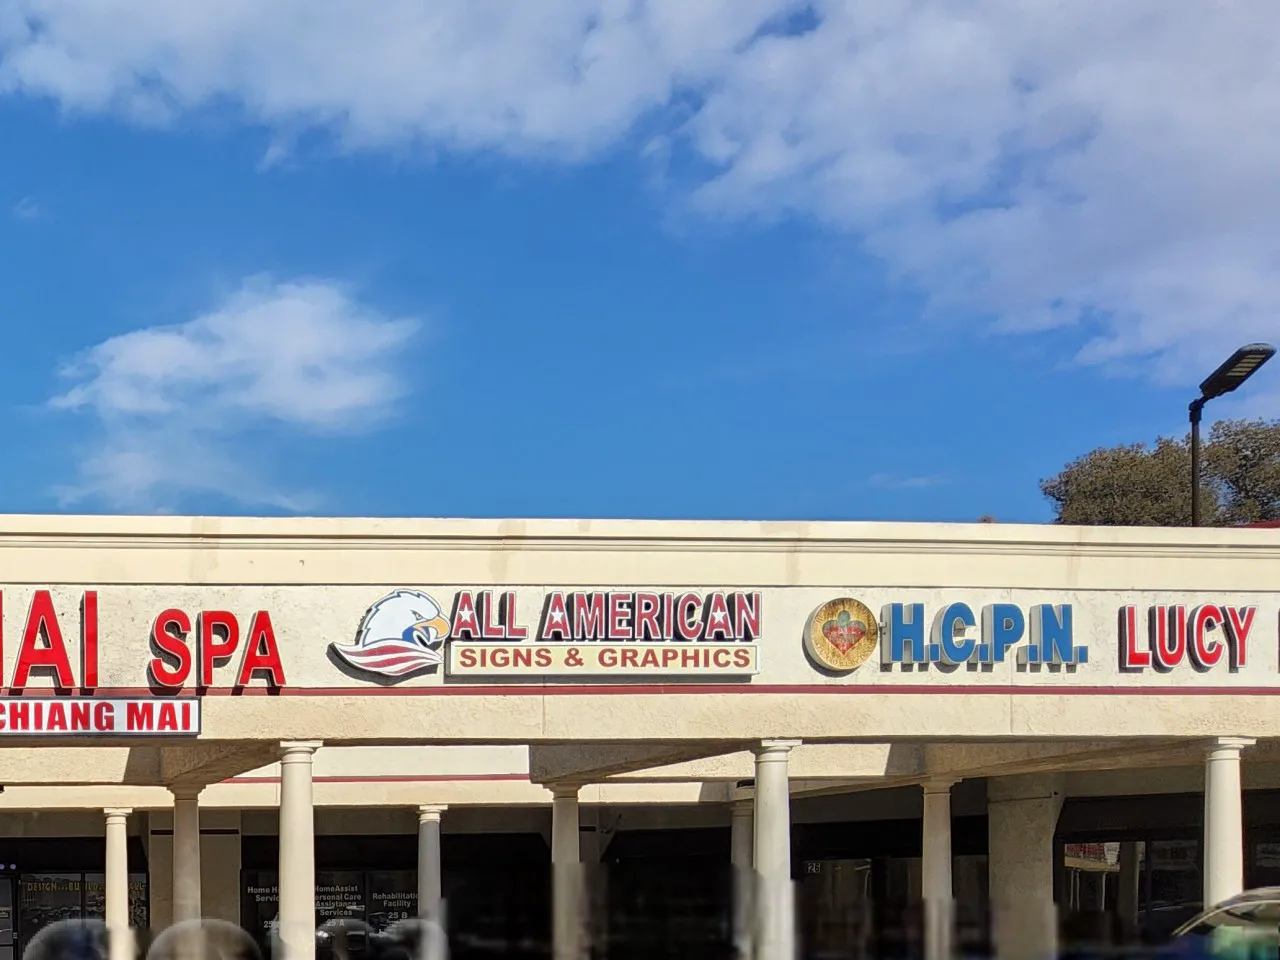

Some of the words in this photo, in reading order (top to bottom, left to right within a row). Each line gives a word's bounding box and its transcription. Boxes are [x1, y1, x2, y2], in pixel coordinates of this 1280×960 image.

[451, 590, 528, 638] ALL
[543, 590, 763, 641] AMERICAN
[889, 602, 1089, 664] H.C.P.N.
[1124, 603, 1258, 669] LUCY
[150, 608, 287, 688] SPA
[458, 647, 553, 668] SIGNS
[564, 647, 585, 667] &
[597, 647, 751, 669] GRAPHICS
[126, 702, 192, 731] MAI
[247, 886, 270, 894] Home
[344, 893, 362, 901] Care
[255, 894, 279, 902] Servic
[383, 899, 412, 908] Facility
[319, 908, 353, 916] Services
[388, 911, 399, 919] 25
